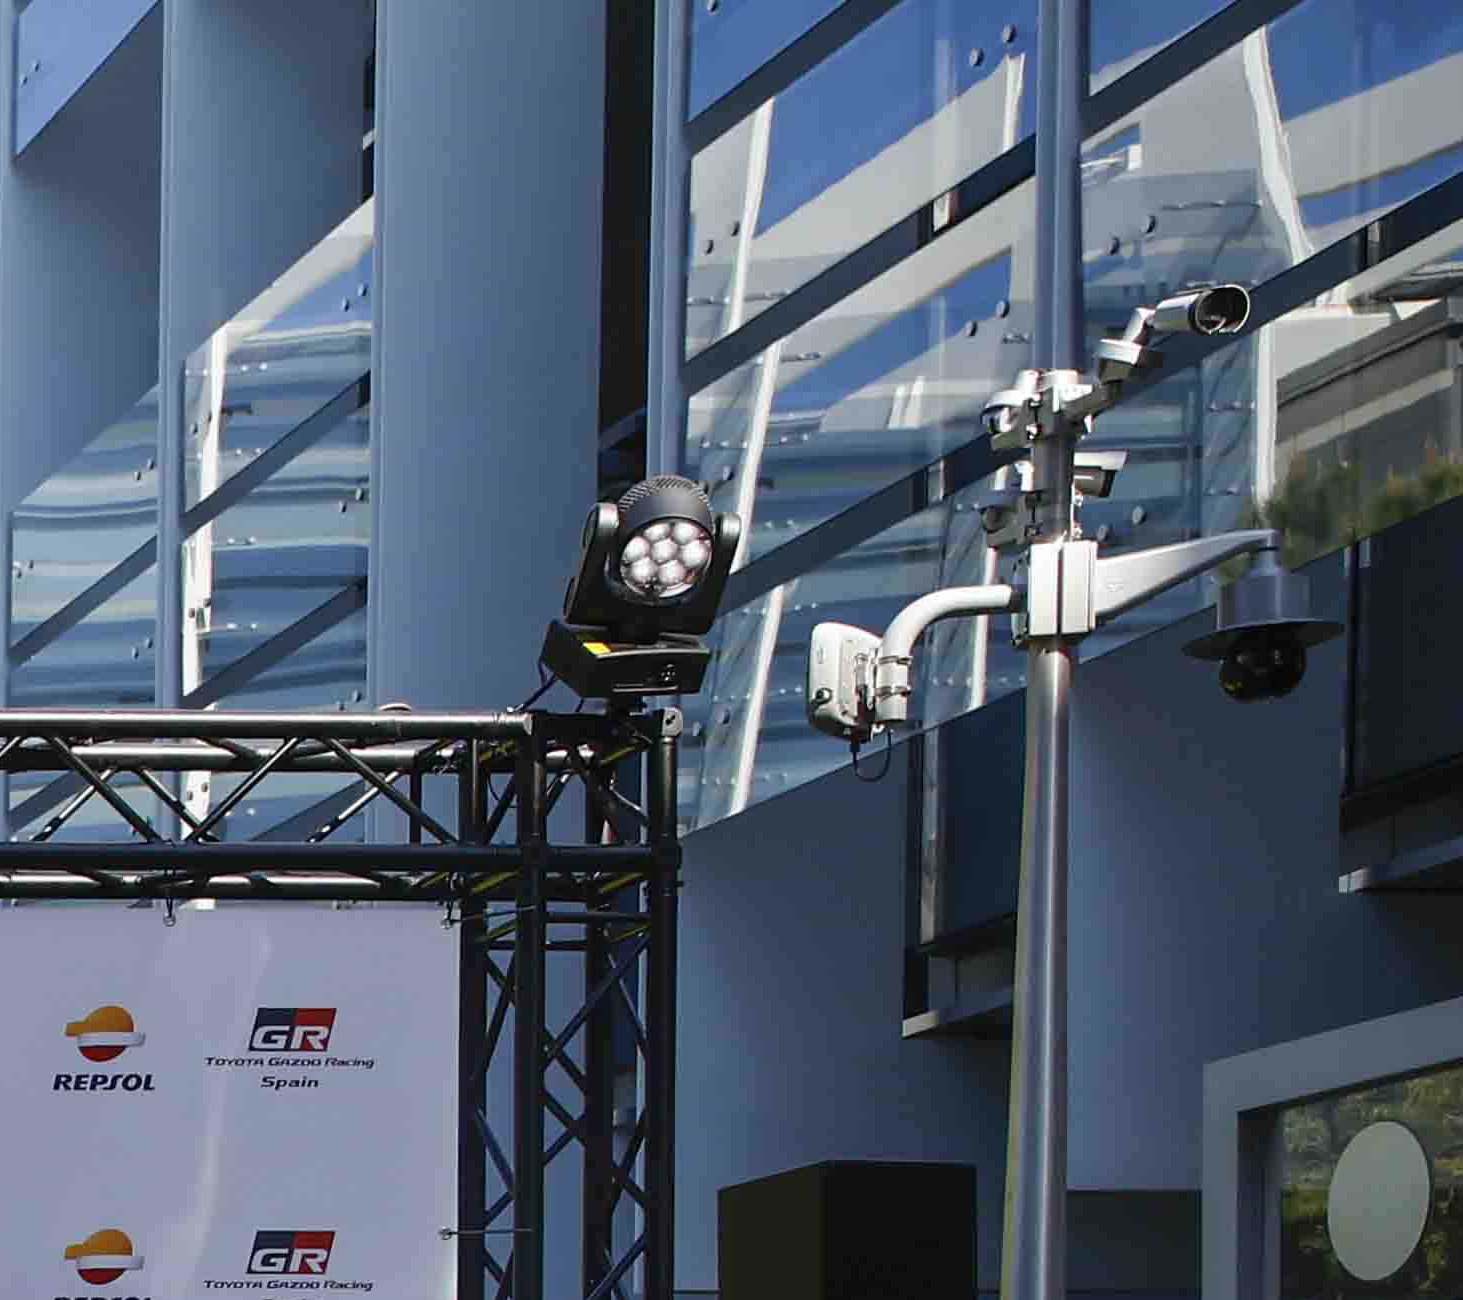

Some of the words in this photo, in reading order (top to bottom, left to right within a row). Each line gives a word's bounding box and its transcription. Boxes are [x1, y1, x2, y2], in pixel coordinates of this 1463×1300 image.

[254, 1026, 330, 1049] GR
[205, 1057, 264, 1067] TOYOTA
[268, 1057, 321, 1066] GAZOO
[325, 1058, 374, 1069] Racing
[53, 1074, 155, 1091] REPSOL
[261, 1076, 318, 1090] Spain
[252, 1249, 328, 1272] GR
[204, 1280, 262, 1288] TOYOTA
[267, 1280, 320, 1289] GAZOO
[323, 1280, 373, 1292] Racing
